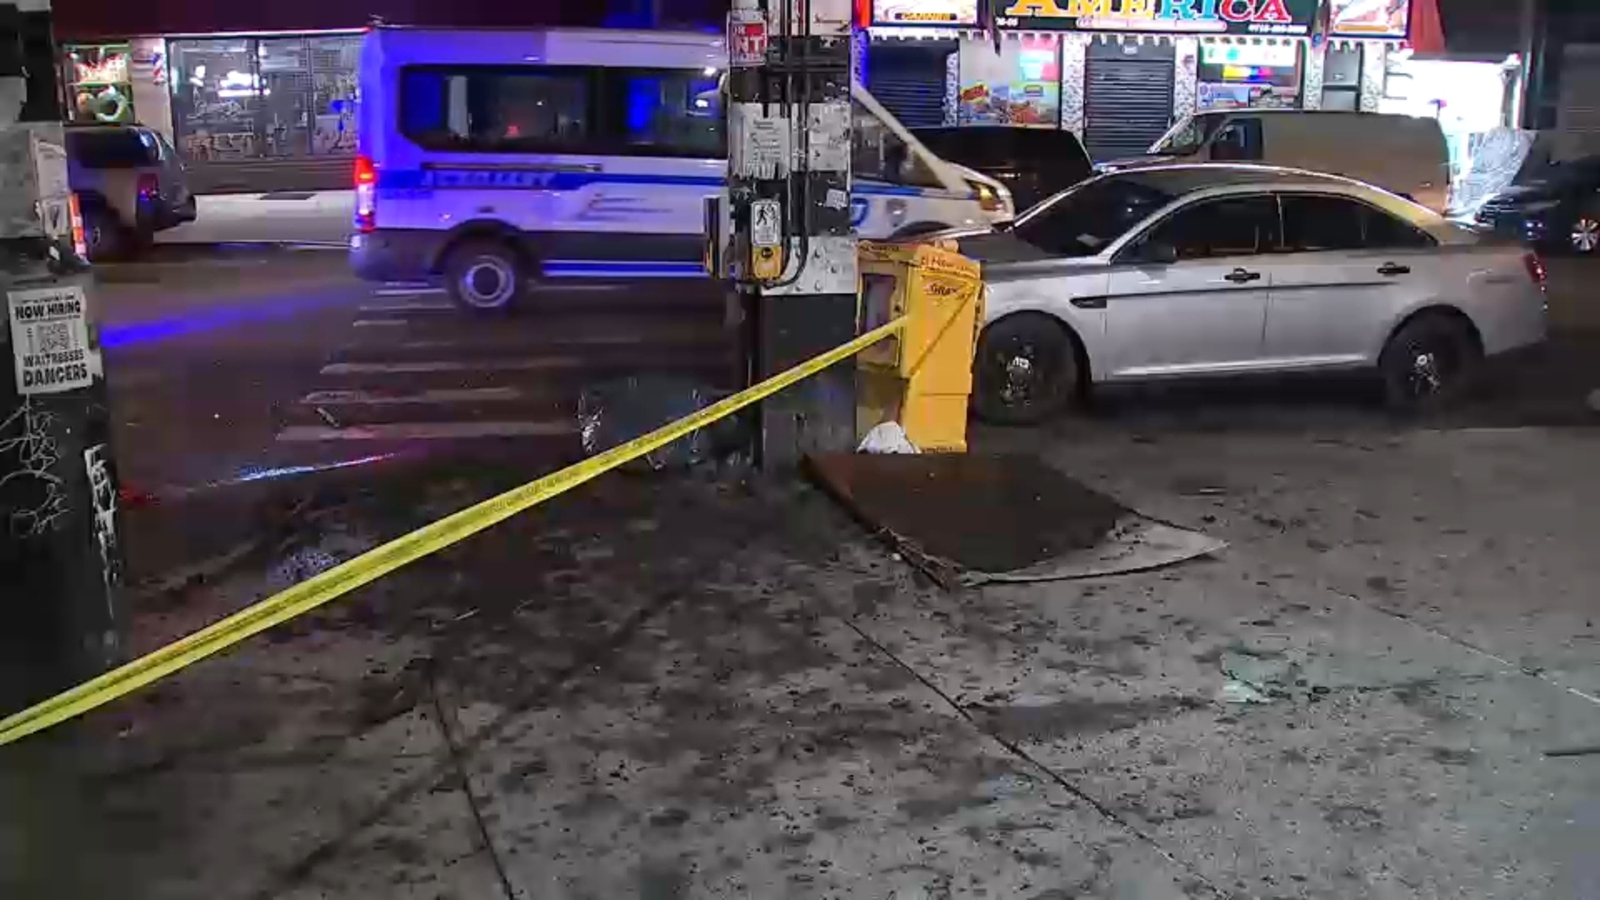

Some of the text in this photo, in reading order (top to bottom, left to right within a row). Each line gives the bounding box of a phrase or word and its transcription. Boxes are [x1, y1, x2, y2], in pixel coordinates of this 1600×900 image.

[1005, 0, 1292, 23] AMERICA
[15, 300, 81, 320] NOW HIRING
[23, 349, 85, 367] WAITRESSES
[23, 363, 88, 387] DANCERS
